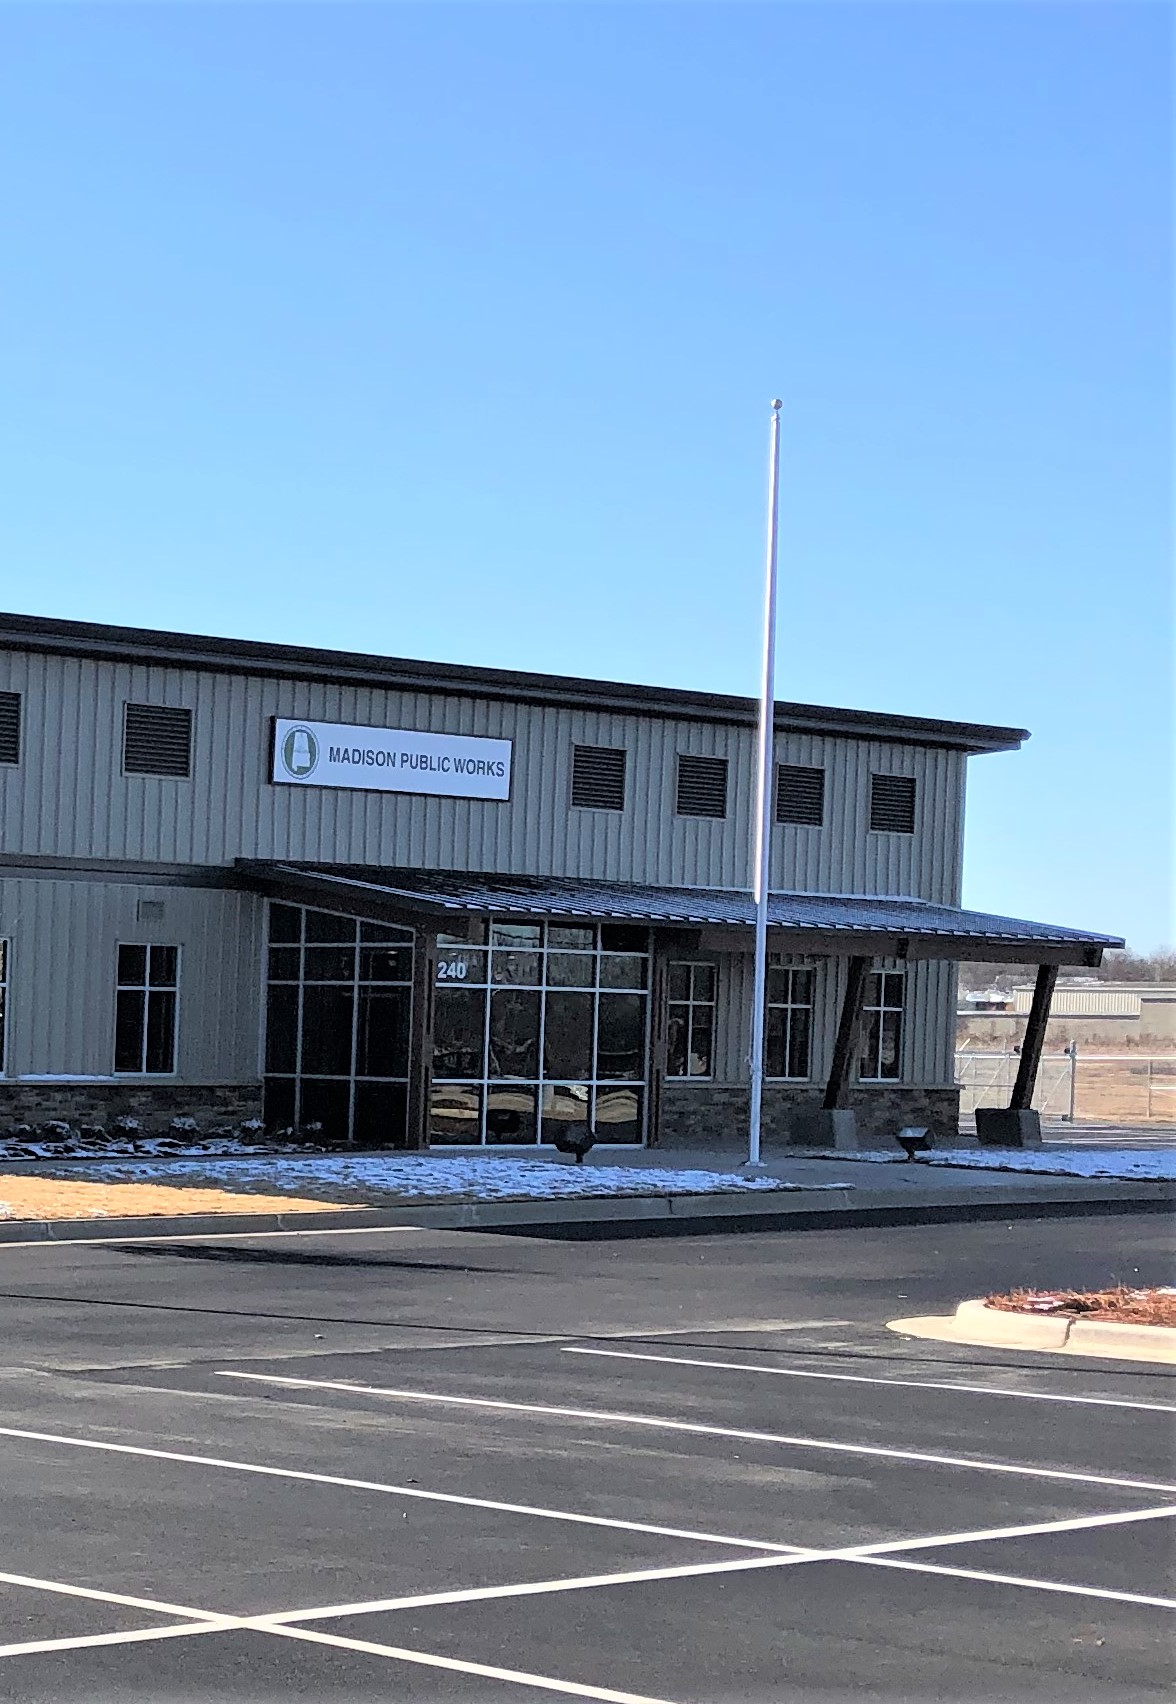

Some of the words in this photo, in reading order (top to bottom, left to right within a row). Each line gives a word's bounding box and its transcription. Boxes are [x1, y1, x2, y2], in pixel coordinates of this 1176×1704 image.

[329, 747, 396, 767] MADISON
[401, 753, 451, 773] PUBLIC
[453, 758, 505, 777] WORKS
[437, 961, 467, 979] 240
